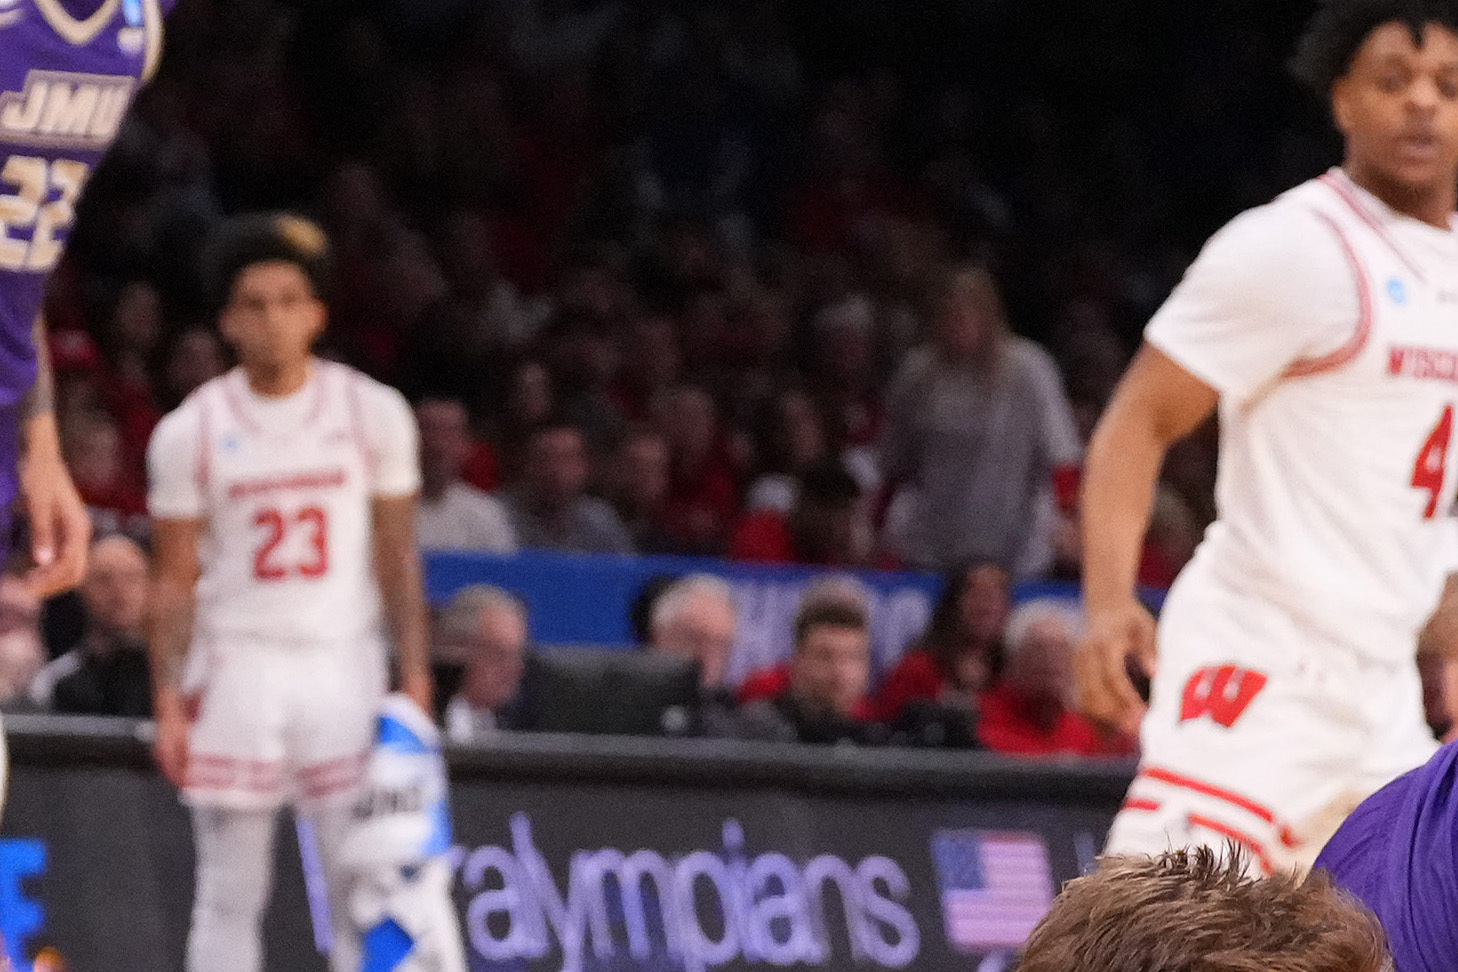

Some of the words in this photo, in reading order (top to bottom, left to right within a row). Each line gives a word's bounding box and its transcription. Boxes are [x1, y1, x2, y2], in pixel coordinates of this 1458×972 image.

[1, 79, 135, 139] JMU
[1410, 404, 1454, 520] 4
[253, 507, 329, 580] 23
[1179, 663, 1268, 728] W
